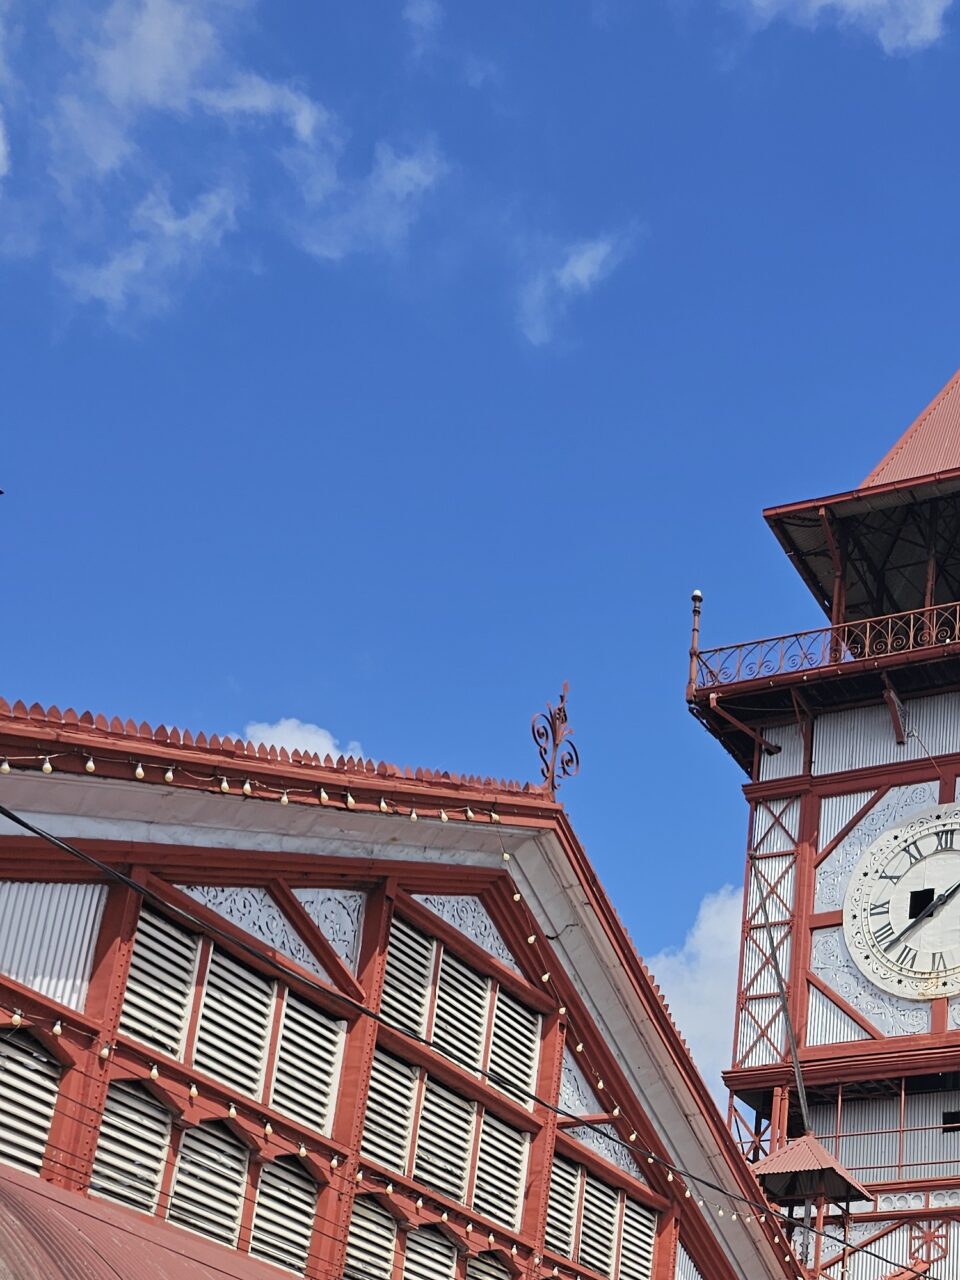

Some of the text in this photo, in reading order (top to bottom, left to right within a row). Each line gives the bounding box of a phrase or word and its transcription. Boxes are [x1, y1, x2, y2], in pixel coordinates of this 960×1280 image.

[934, 829, 956, 851] XII
[902, 840, 925, 865] XI
[879, 870, 902, 886] X
[870, 899, 890, 917] IX
[895, 944, 918, 970] VII
[931, 952, 947, 971] VI
